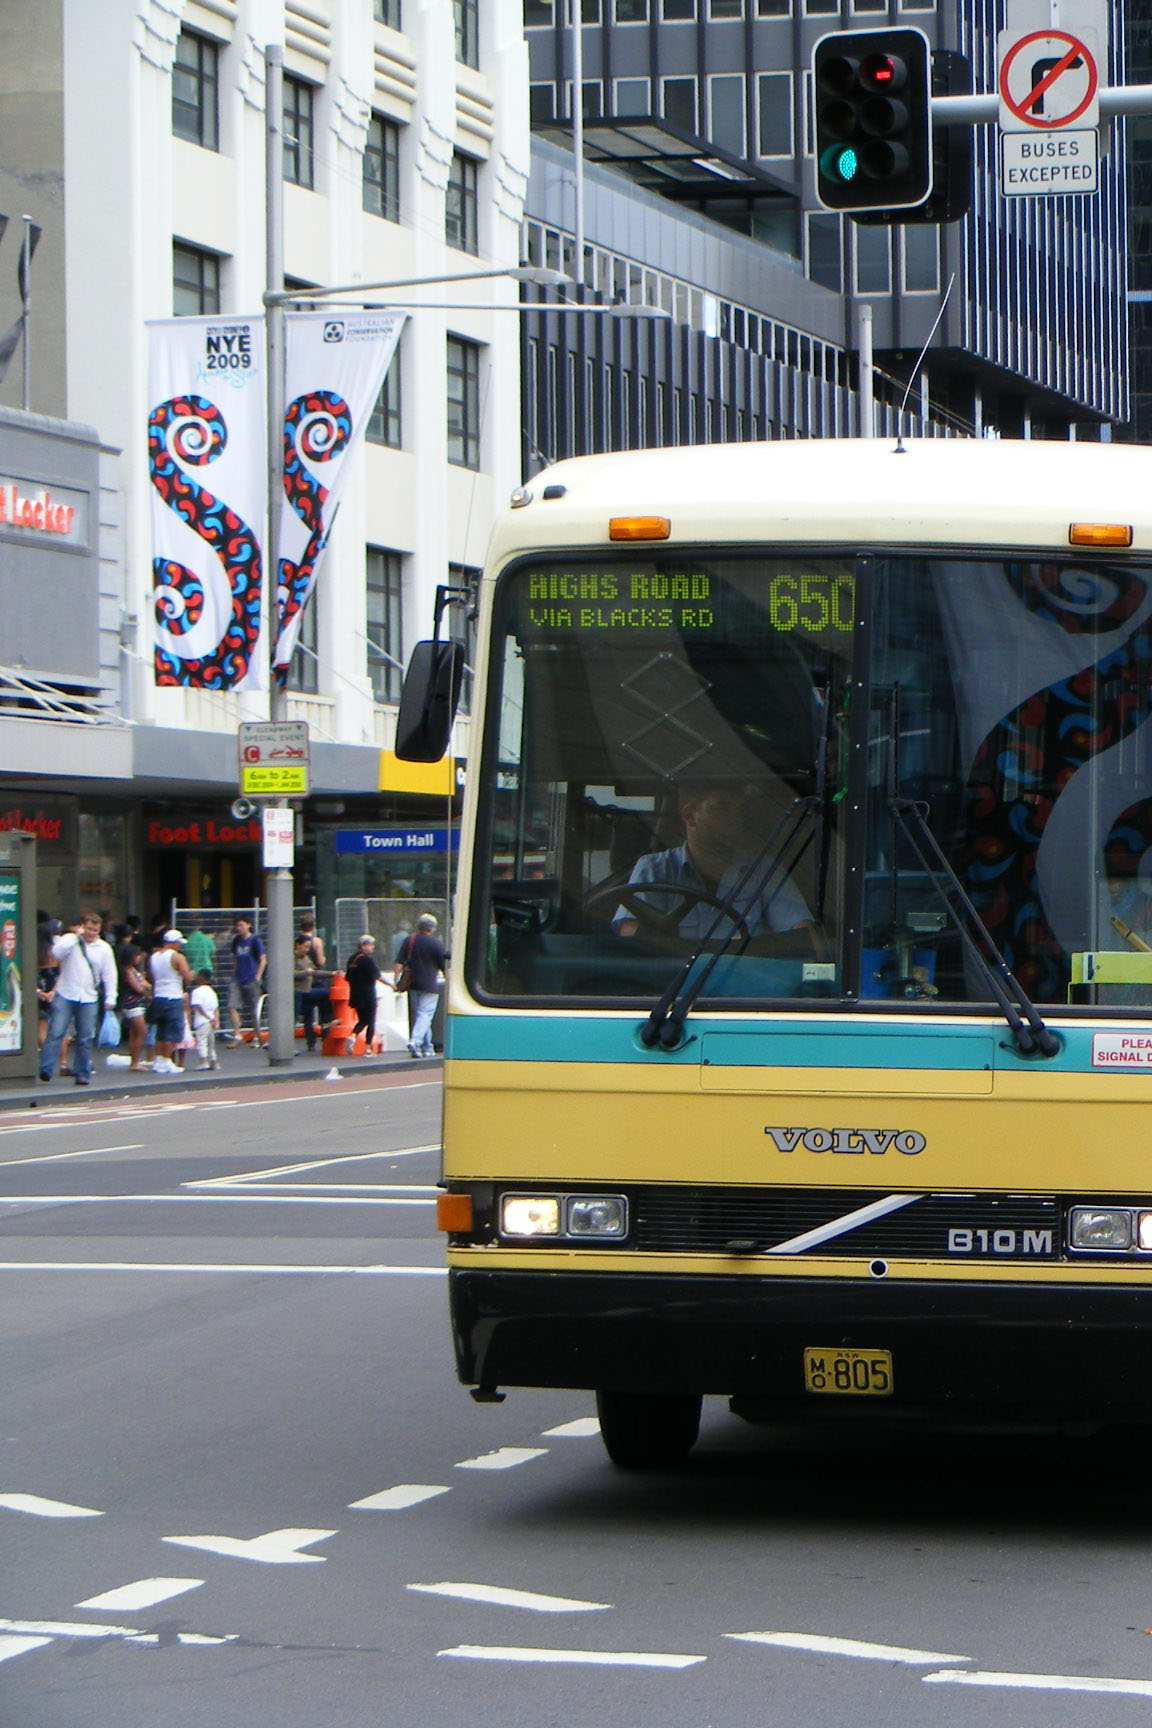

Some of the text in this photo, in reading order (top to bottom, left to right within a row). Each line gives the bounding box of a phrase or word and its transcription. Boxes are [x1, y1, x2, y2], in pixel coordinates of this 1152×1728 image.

[1021, 141, 1079, 158] BUSES
[1009, 165, 1092, 183] EXCEPTED
[206, 335, 251, 353] NYE
[207, 354, 251, 369] 2009
[12, 485, 75, 534] Locker
[529, 574, 710, 599] HIGHS ROAD
[769, 575, 856, 632] 650
[529, 608, 714, 627] VIA BLACKS RD
[148, 822, 201, 844] Foot
[206, 820, 263, 843] Lock
[363, 833, 434, 848] Town Hall
[1097, 1051, 1143, 1063] SIGNAL
[764, 1126, 927, 1156] VOLVO
[949, 1228, 1053, 1254] B10M
